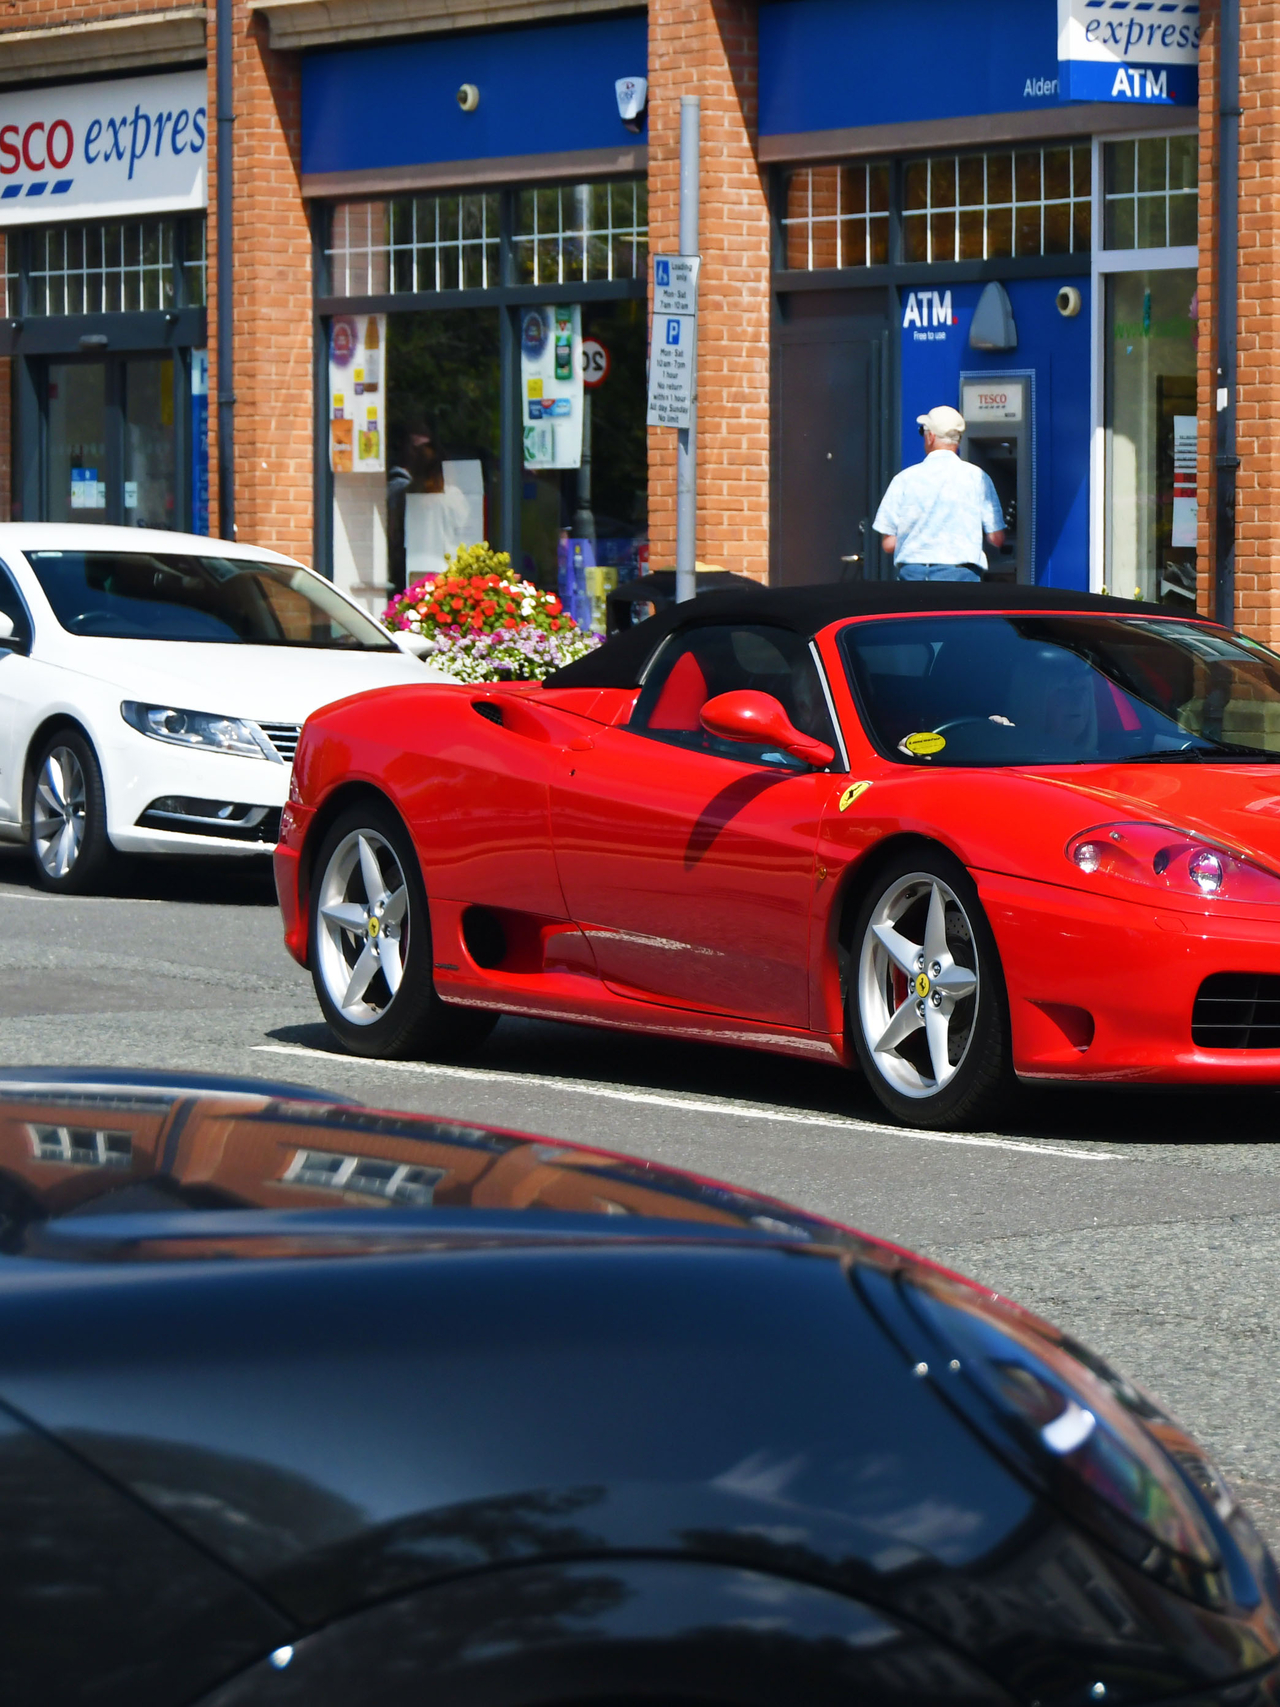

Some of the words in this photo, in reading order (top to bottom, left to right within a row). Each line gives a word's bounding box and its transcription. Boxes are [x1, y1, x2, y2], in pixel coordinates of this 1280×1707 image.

[0, 119, 74, 175] SCO
[84, 104, 206, 180] expres
[671, 262, 692, 272] Loading
[676, 274, 687, 282] only
[913, 331, 927, 341] Free
[927, 331, 935, 341] to
[935, 331, 946, 341] use
[667, 371, 678, 379] hour
[978, 394, 1007, 404] TESCO
[669, 404, 688, 414] Sunday
[658, 414, 665, 422] No
